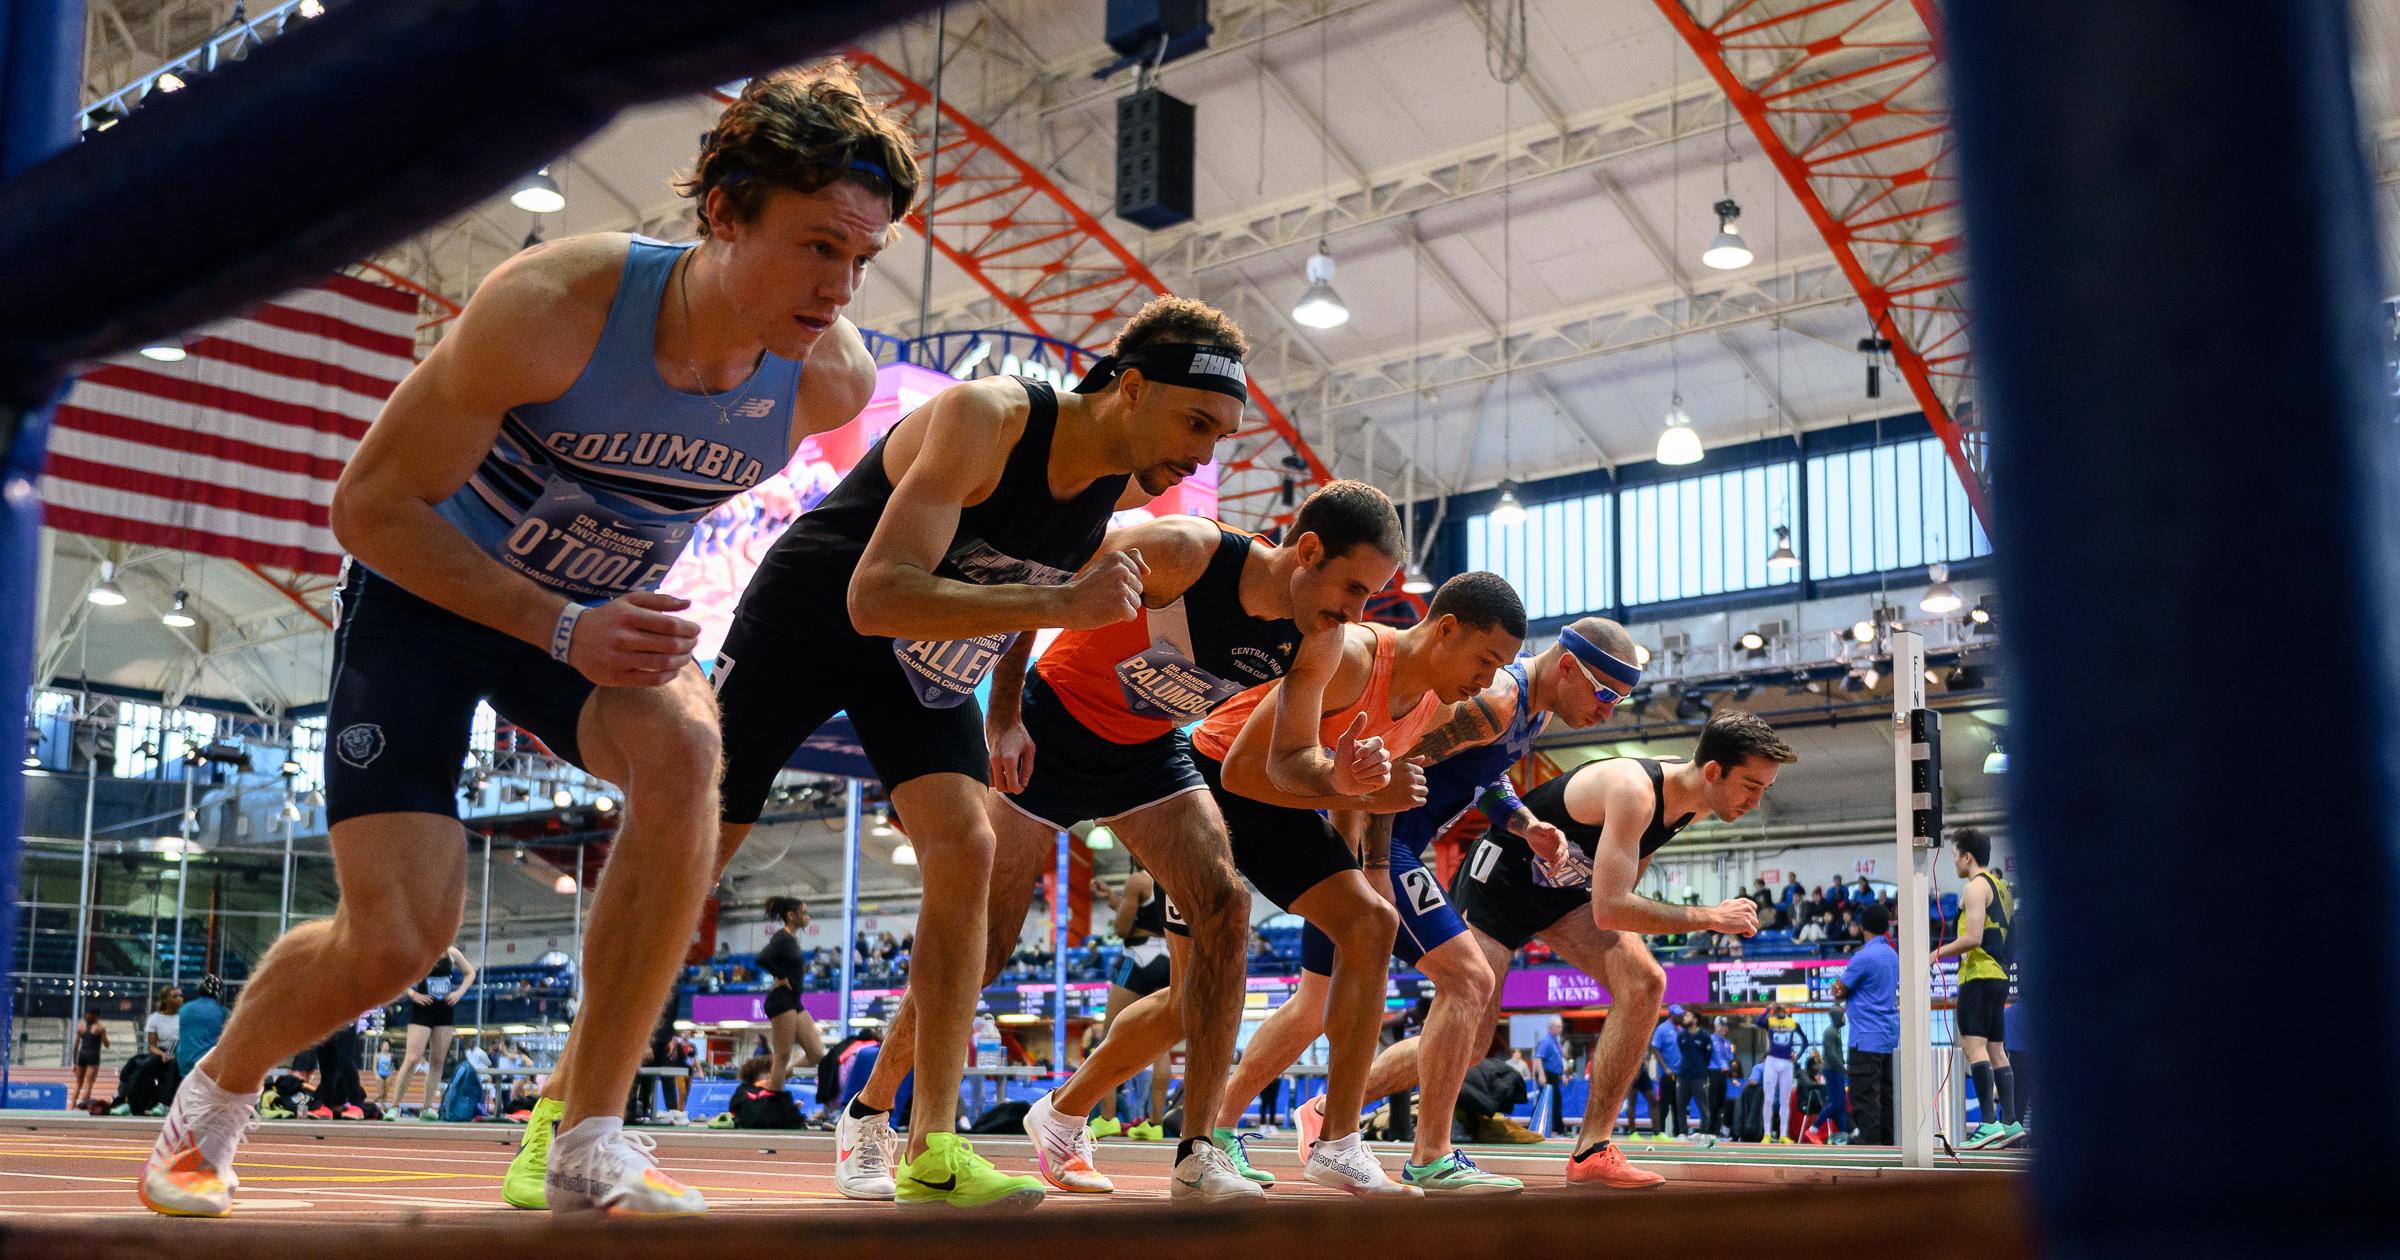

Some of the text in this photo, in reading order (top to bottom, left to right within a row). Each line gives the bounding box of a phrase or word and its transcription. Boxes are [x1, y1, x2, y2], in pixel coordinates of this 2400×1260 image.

[546, 431, 764, 488] COLUMBIA
[568, 522, 646, 558] INVITATIONAL
[576, 514, 598, 531] DR.
[600, 528, 654, 549] SANDER
[504, 554, 567, 589] COLUMBIA
[507, 517, 670, 594] O'TOOLE
[896, 649, 943, 684] COLUMBIA
[1167, 663, 1181, 674] DR.
[1180, 671, 1213, 690] SANDER
[1231, 647, 1283, 676] CENTRAL PARK
[1233, 659, 1270, 680] TRACK CLUB
[1118, 671, 1152, 701] COLUMBIA
[1120, 656, 1217, 714] PALUMBO
[1474, 845, 1492, 877] 1
[1856, 859, 1876, 873] 447
[1407, 871, 1441, 911] 2
[1548, 987, 1600, 1001] EVENTS
[1313, 1152, 1371, 1184] new balance
